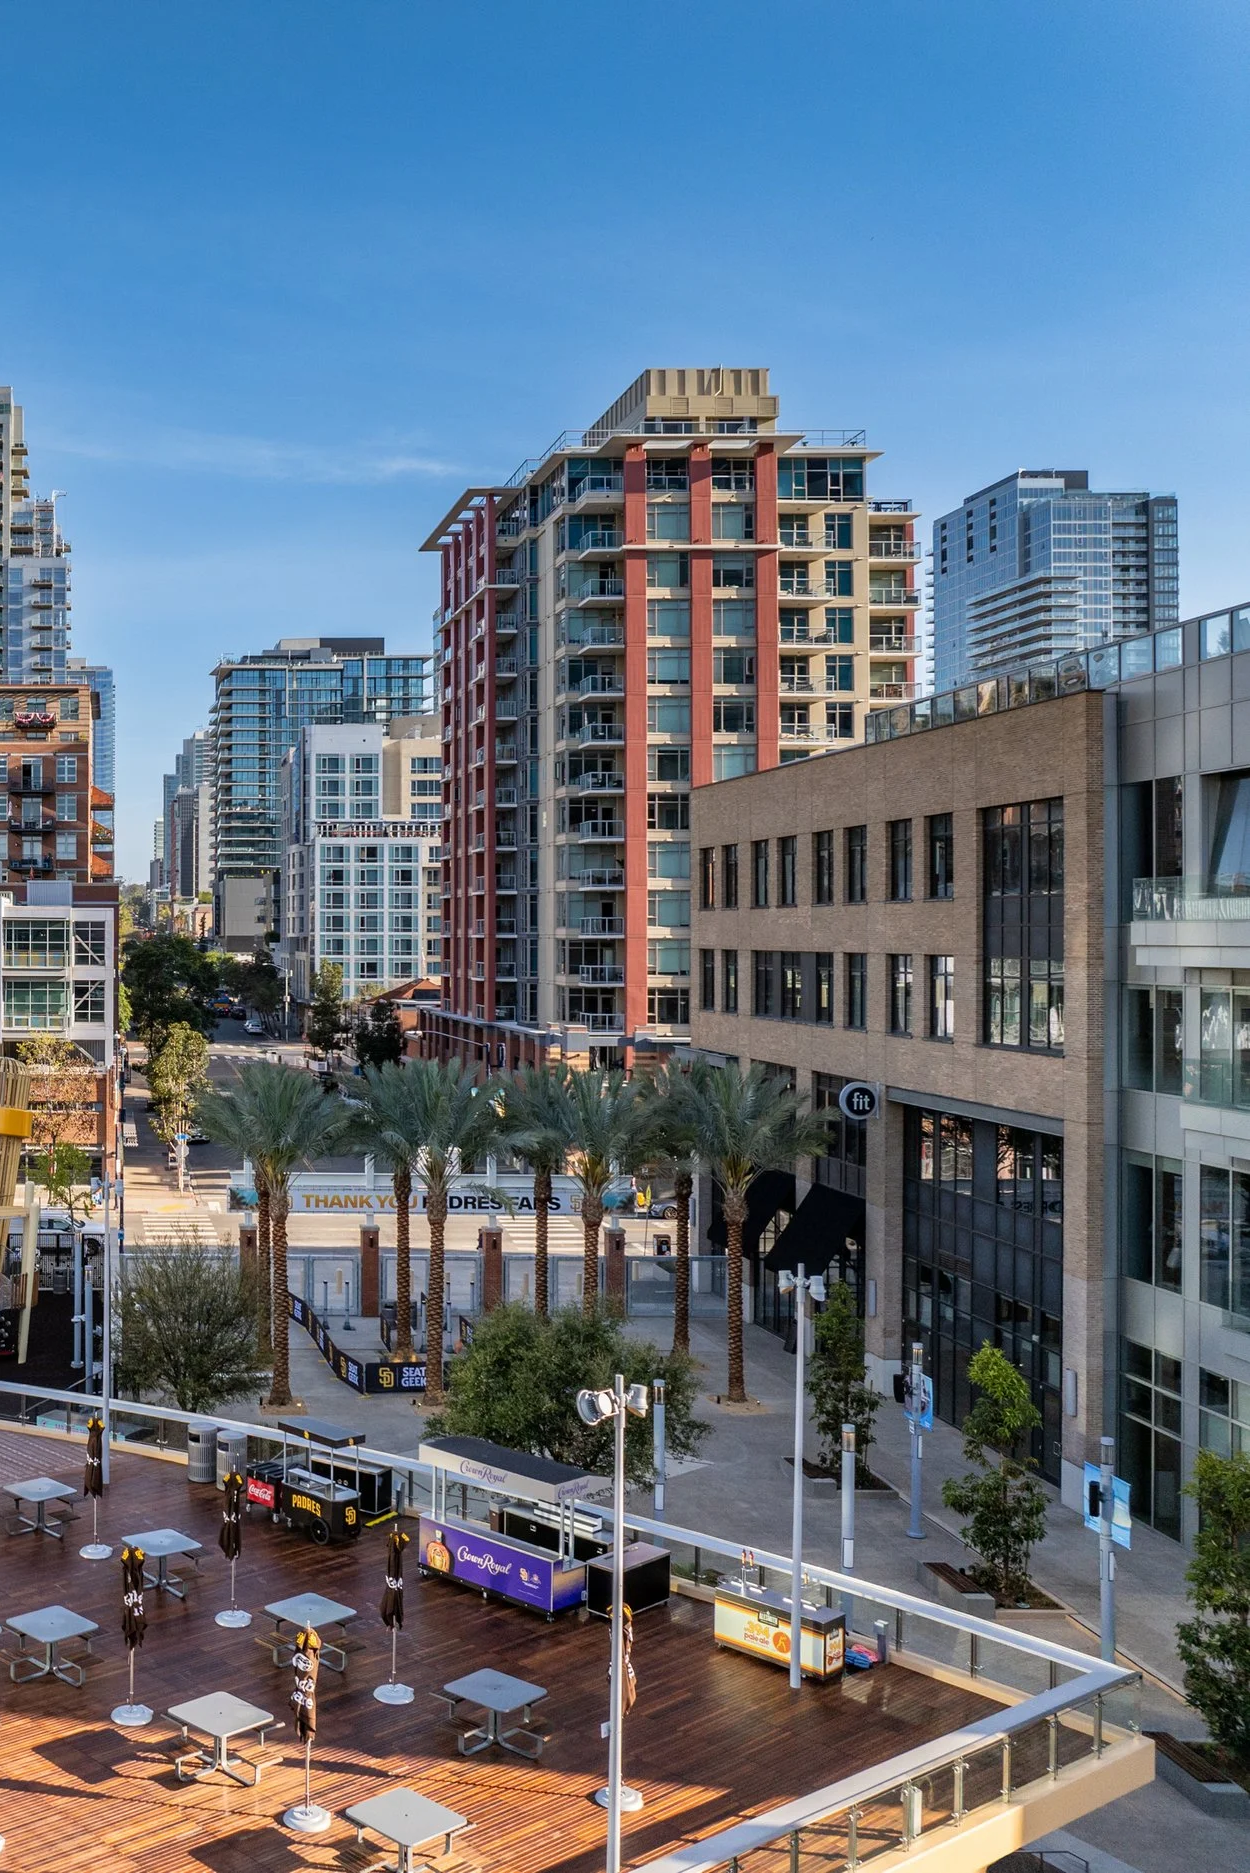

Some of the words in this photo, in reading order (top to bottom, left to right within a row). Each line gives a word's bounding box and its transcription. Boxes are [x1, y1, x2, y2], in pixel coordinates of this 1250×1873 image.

[852, 1092, 870, 1110] fit
[302, 1194, 373, 1208] THANK
[402, 1367, 426, 1377] SEAT
[401, 1377, 426, 1387] GEEK
[460, 1460, 484, 1480] Crown
[481, 1468, 508, 1484] Royal
[249, 1484, 272, 1501] Coca-Cola
[292, 1494, 321, 1517] PADRES
[457, 1546, 484, 1567] Crown
[478, 1554, 512, 1575] Royal
[744, 1632, 758, 1641] pale
